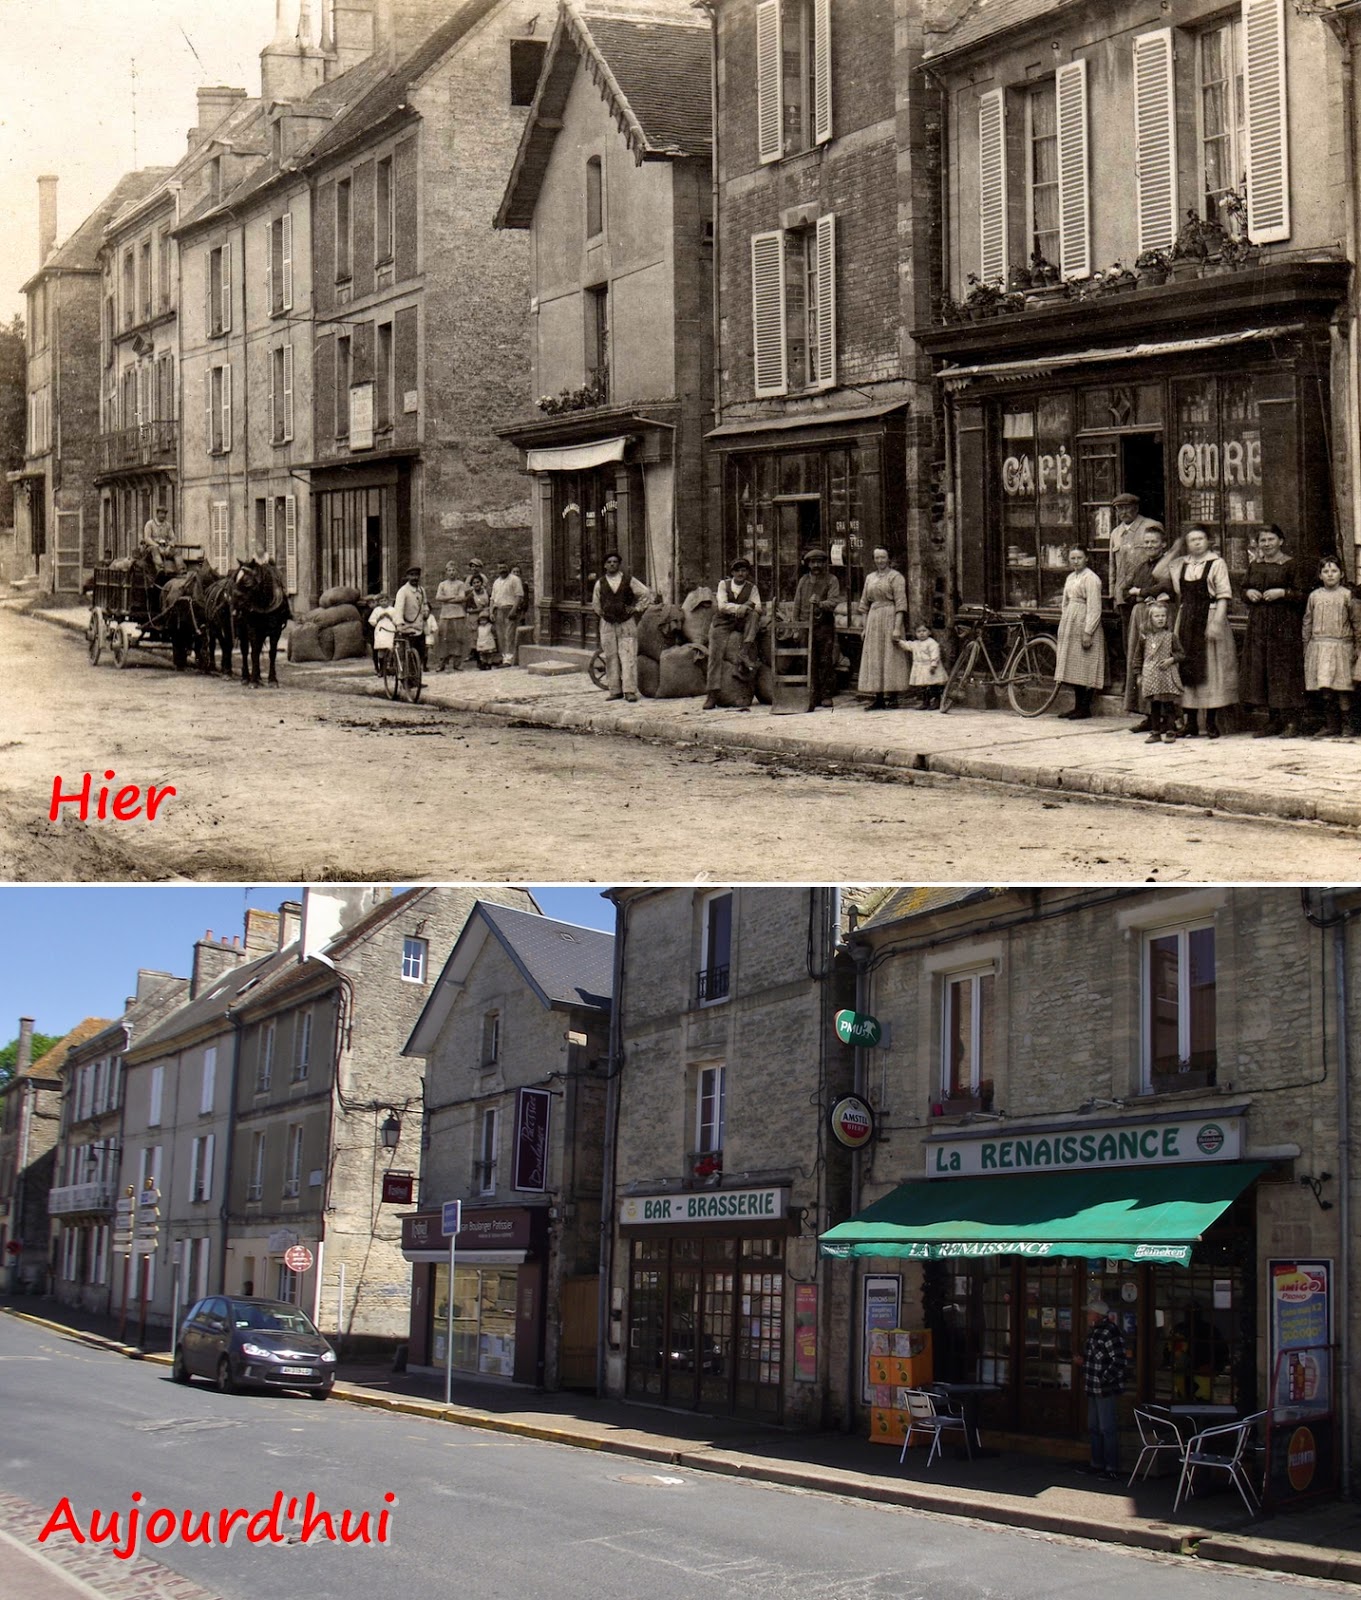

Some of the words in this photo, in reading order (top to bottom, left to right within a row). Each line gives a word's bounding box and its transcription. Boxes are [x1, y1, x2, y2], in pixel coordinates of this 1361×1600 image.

[840, 1020, 863, 1035] PMU
[843, 1112, 868, 1125] AMSTEL
[936, 1147, 961, 1172] La
[981, 1127, 1180, 1169] RENAISSANCE
[644, 1199, 672, 1219] BAR
[688, 1192, 775, 1218] BRASSERIE
[908, 1242, 930, 1257] LA
[938, 1242, 1054, 1257] RENAISSANCE
